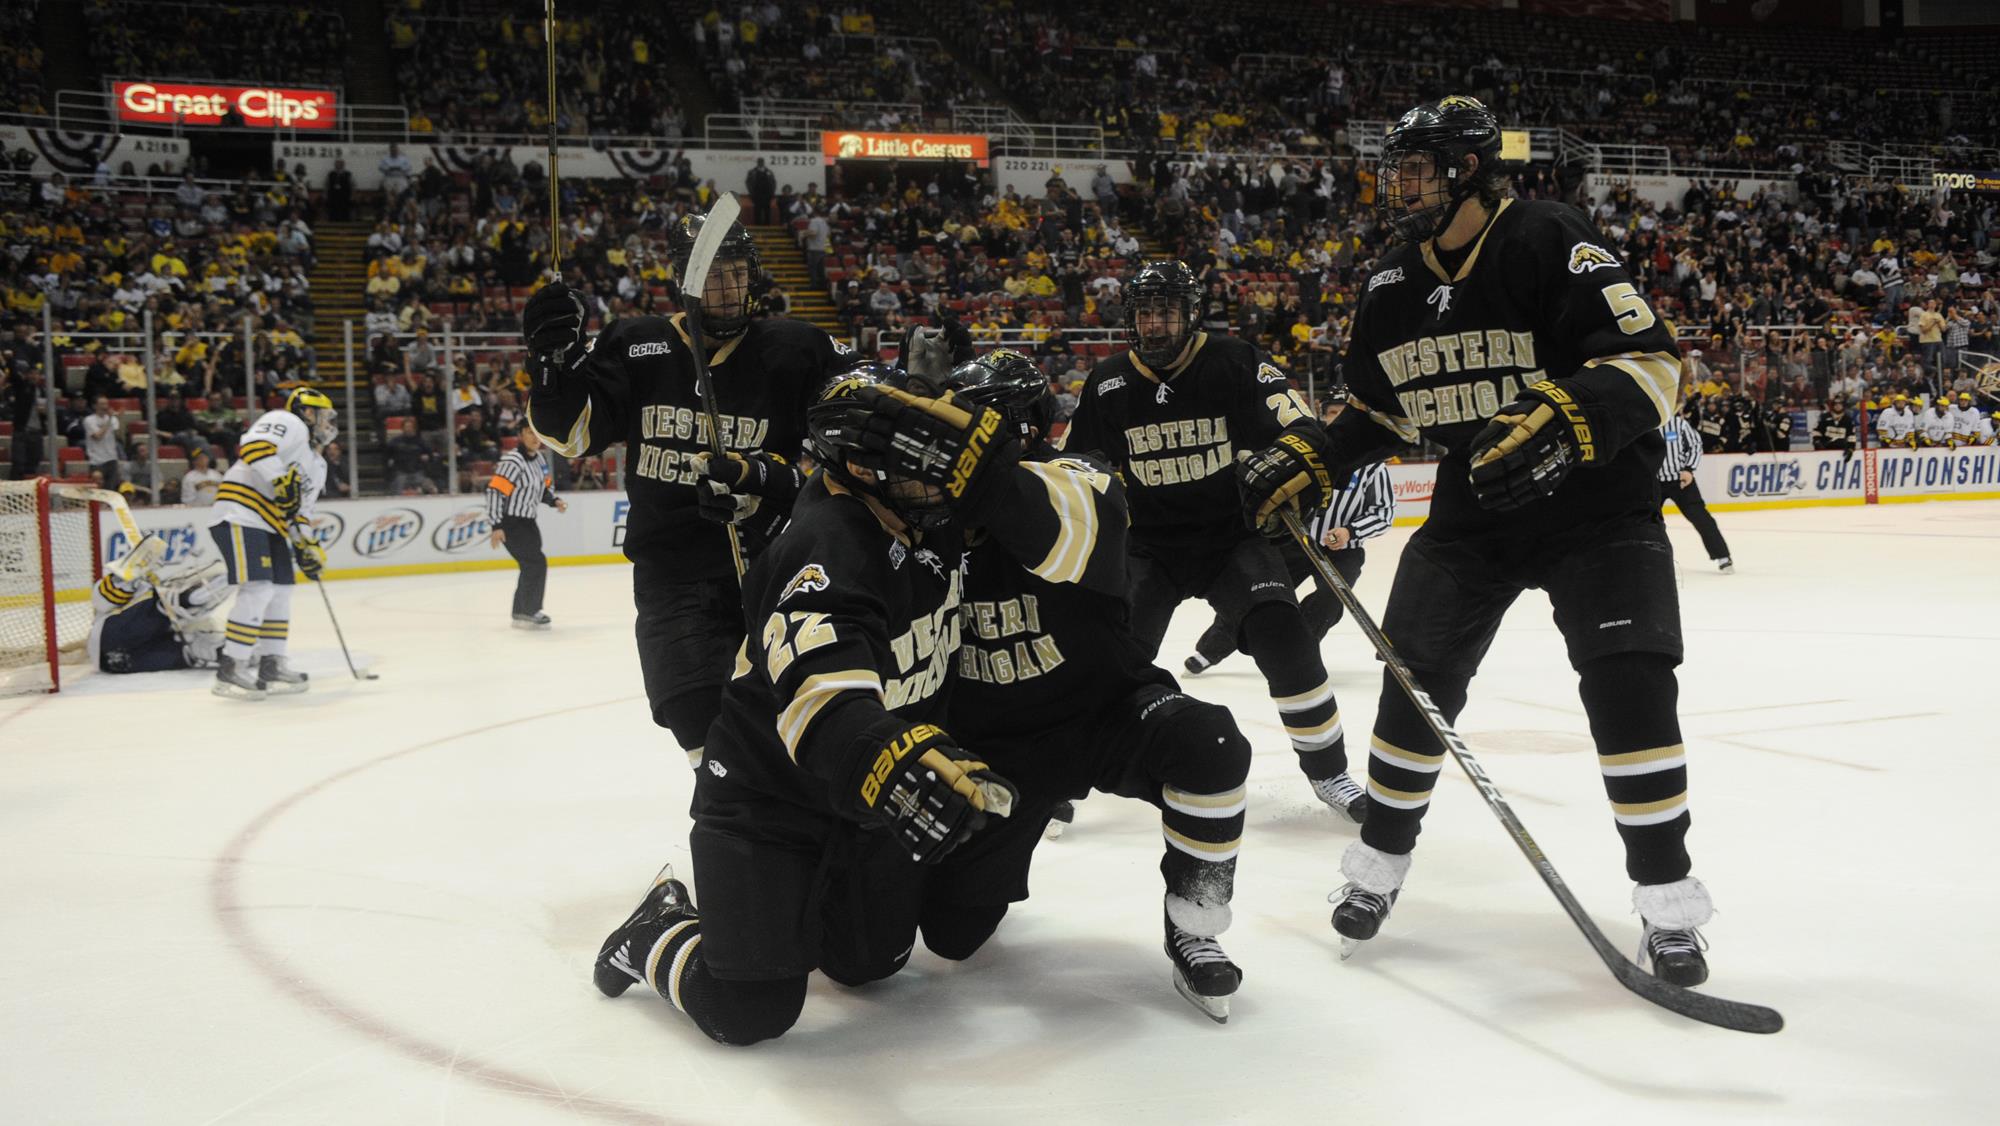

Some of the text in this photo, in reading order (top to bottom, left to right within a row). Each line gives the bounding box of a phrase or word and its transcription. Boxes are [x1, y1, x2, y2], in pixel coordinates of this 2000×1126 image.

[124, 84, 319, 126] Great Clips
[769, 156, 817, 167] 219 220
[867, 138, 973, 158] Little Caesars
[1005, 161, 1049, 171] 220 221
[1933, 172, 1976, 190] more
[1602, 282, 1655, 335] 5
[1377, 329, 1537, 387] WESTERN
[255, 423, 287, 438] 39
[1531, 380, 1595, 463] BAUER
[1279, 434, 1334, 509] BAUER
[1865, 452, 1877, 497] Reebok
[763, 611, 838, 684] 22
